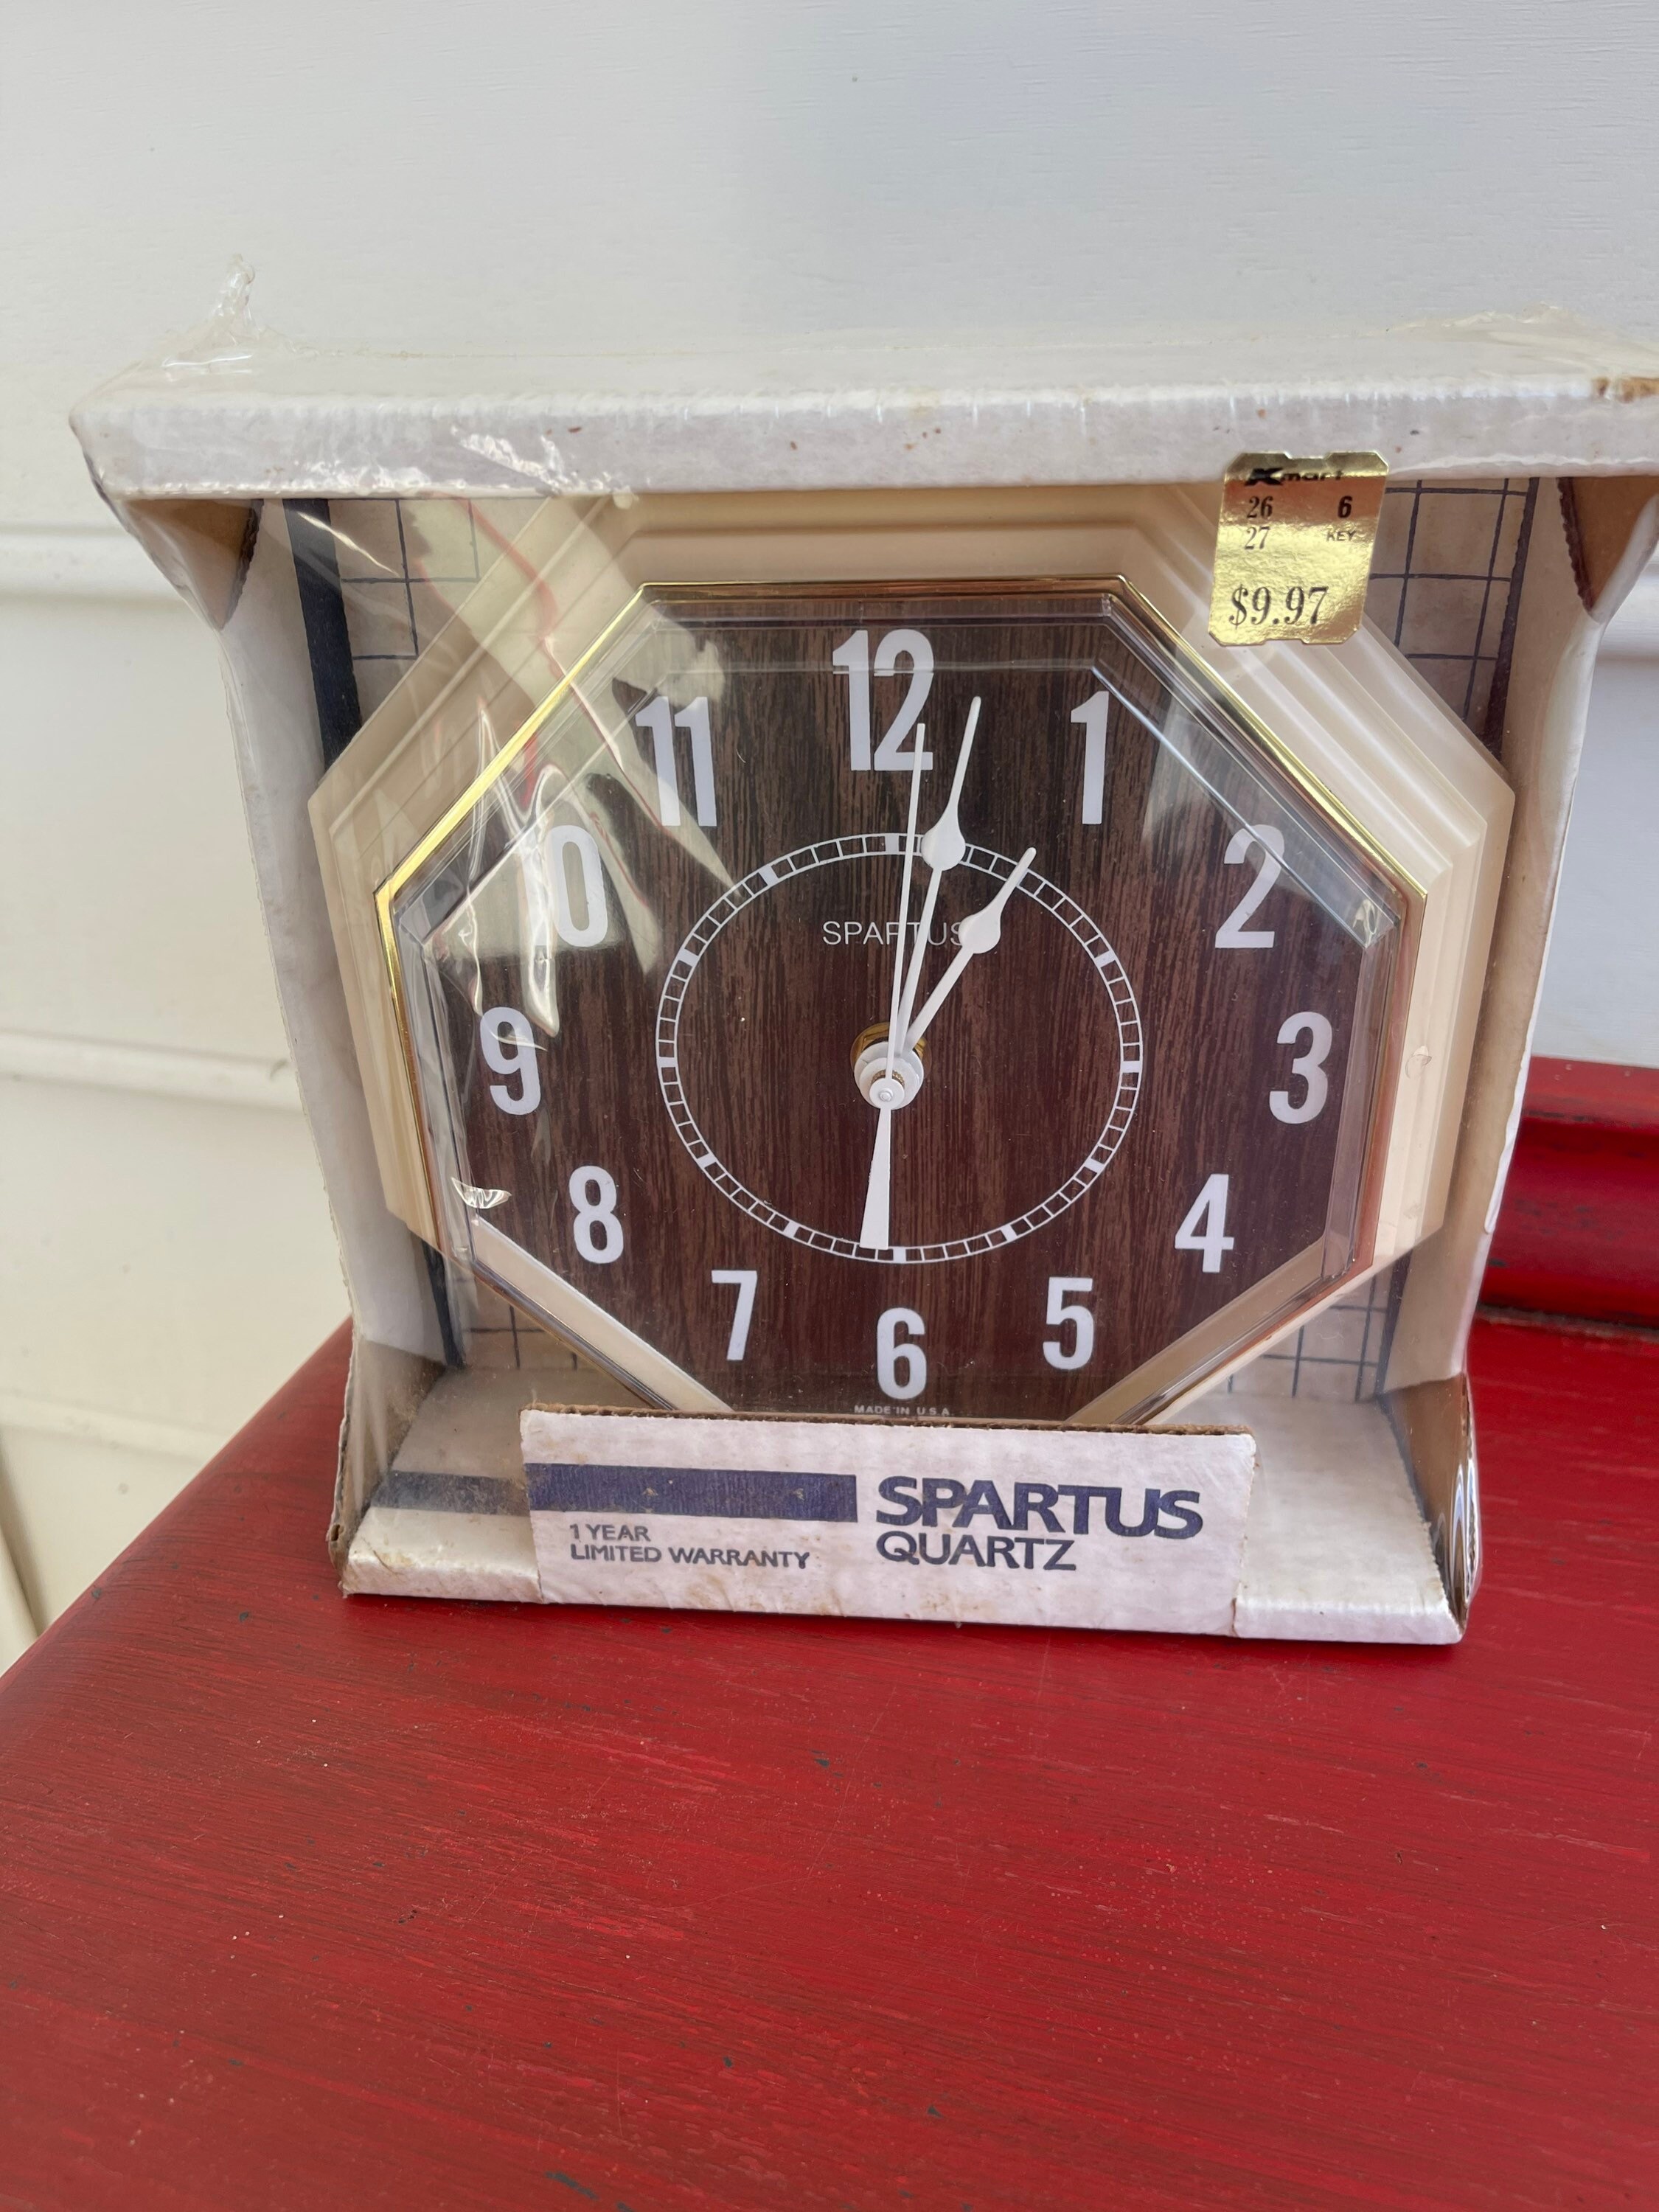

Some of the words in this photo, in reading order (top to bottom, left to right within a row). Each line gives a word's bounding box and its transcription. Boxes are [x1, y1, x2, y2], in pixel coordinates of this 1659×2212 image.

[1245, 526, 1271, 550] 27
[1246, 495, 1273, 519] 26
[1326, 530, 1357, 542] KEY
[1338, 495, 1353, 518] 6
[1228, 585, 1329, 630] $9.97
[832, 629, 935, 771] 12
[635, 696, 717, 827] 11
[1070, 690, 1109, 825] 1
[1214, 824, 1285, 949] 2
[479, 1006, 541, 1116] 9
[1269, 1012, 1333, 1124] 3
[568, 1165, 624, 1265] 8
[1175, 1173, 1234, 1273] 4
[711, 1270, 757, 1361] 7
[876, 1307, 928, 1399] 6
[1043, 1277, 1095, 1371] 5
[854, 1405, 891, 1414] MADE
[895, 1406, 910, 1415] IN
[570, 1523, 580, 1540] 1
[585, 1523, 651, 1542] YEAR
[876, 1475, 1204, 1540] SPARTUS
[876, 1530, 1077, 1571] QUARTZ
[570, 1543, 662, 1563] LIMITED
[667, 1546, 810, 1570] WARRANTY
